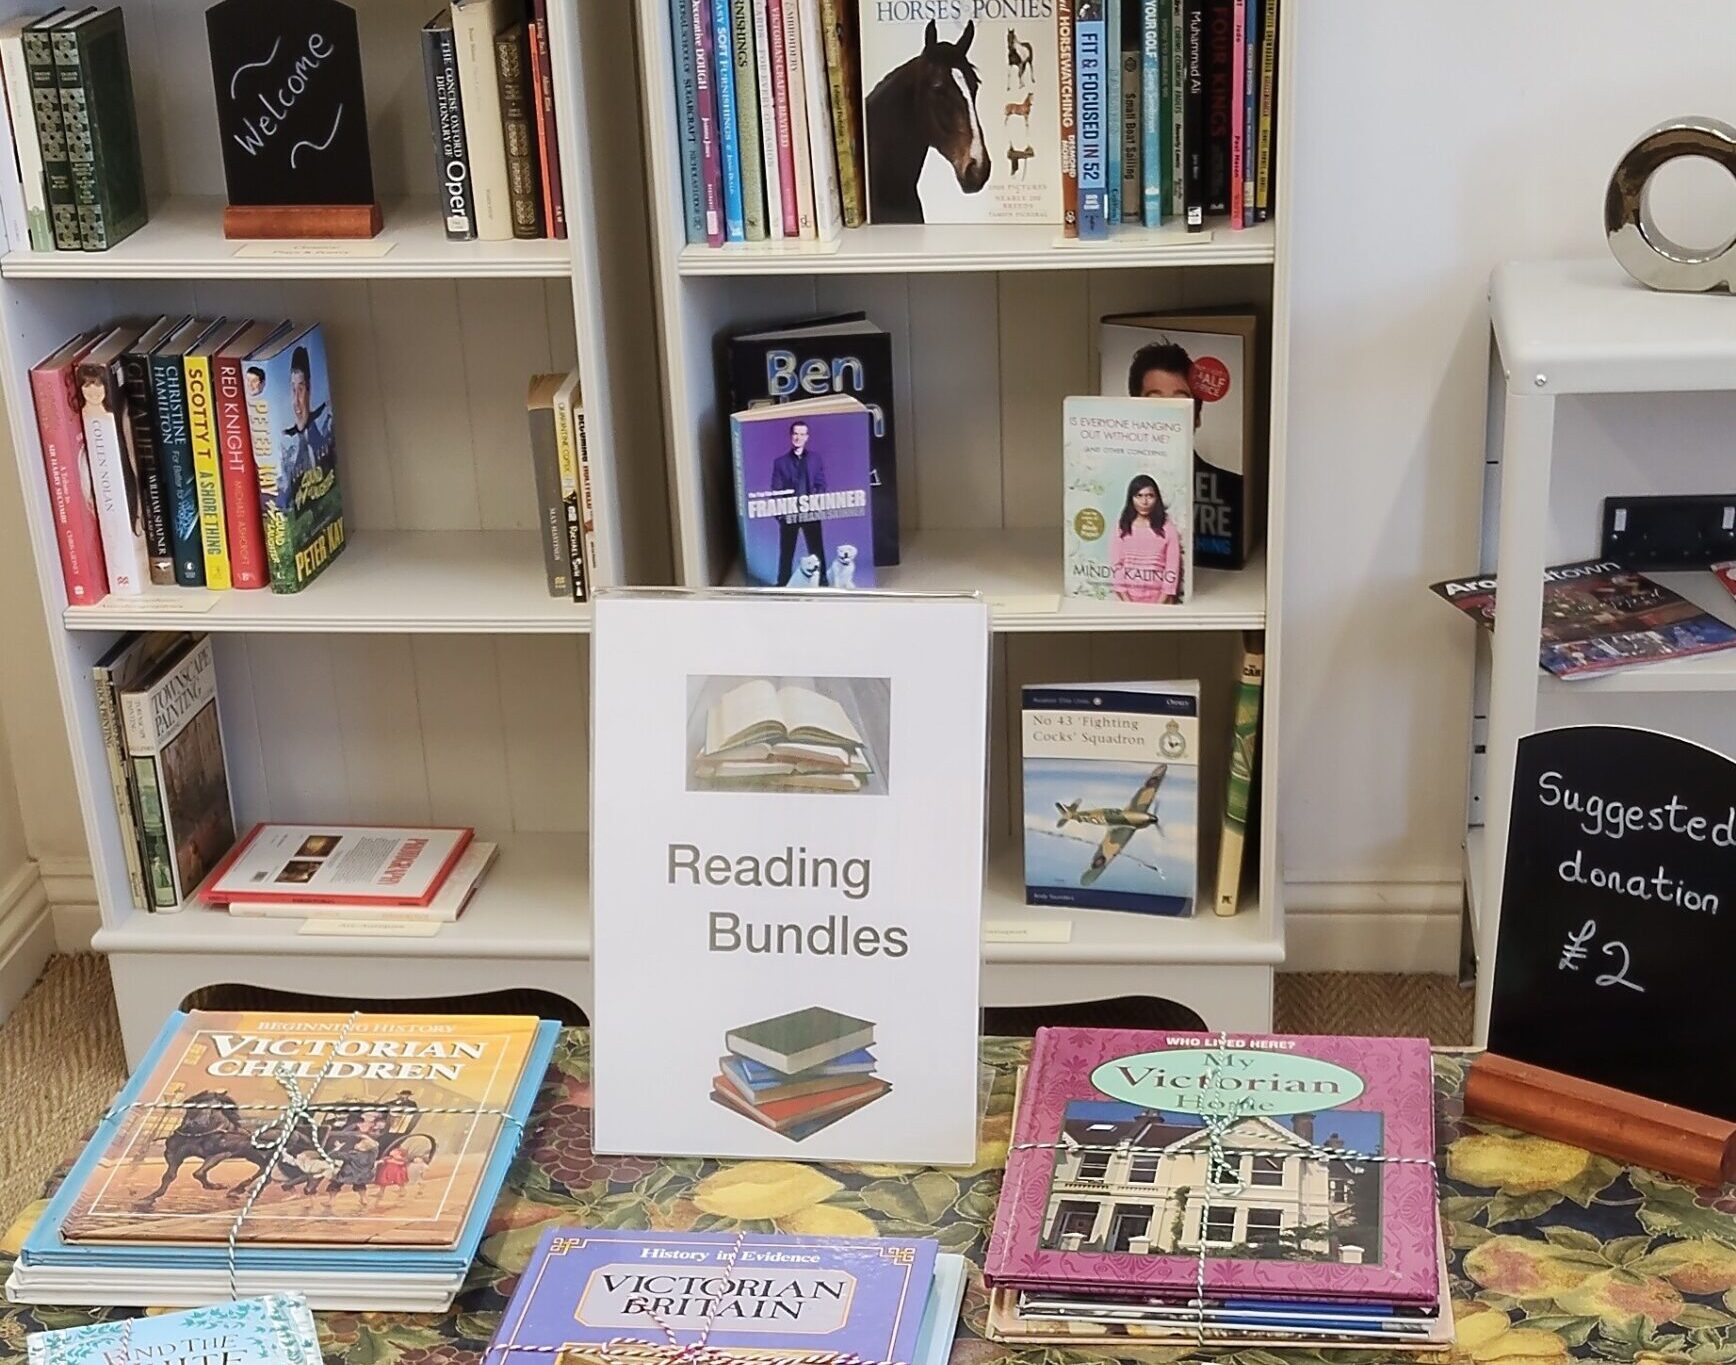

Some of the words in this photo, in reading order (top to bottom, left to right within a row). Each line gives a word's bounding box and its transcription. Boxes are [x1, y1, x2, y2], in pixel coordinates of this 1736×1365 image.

[692, 0, 704, 47] ecorative
[876, 0, 961, 22] HORSES
[972, 0, 1054, 19] PONIES
[1144, 0, 1158, 30] YOUR
[717, 27, 728, 57] SOFT
[770, 7, 784, 63] VICTORIAN
[1081, 33, 1099, 55] FIT
[1145, 31, 1159, 59] GOLF
[1189, 11, 1202, 77] Muhammad
[1213, 7, 1229, 65] FOUR
[440, 40, 452, 65] THE
[696, 48, 709, 89] DOUGH
[1082, 60, 1097, 69] &
[775, 64, 787, 104] CRAFTS
[1059, 17, 1075, 128] HORSEWATCHING
[1190, 79, 1202, 94] Ali
[232, 29, 336, 158] Welcome
[443, 67, 458, 112] CONCISE
[719, 60, 732, 141] FURNISHINGS
[761, 75, 770, 110] EVERY
[1212, 72, 1228, 137] KINGS
[435, 75, 451, 142] DICTIONARY
[443, 144, 453, 158] OF
[684, 78, 697, 143] SUGARCRAFT
[1081, 73, 1100, 140] FOCUSED
[1124, 93, 1137, 120] Small
[448, 114, 463, 158] OXFORD
[778, 105, 790, 148] REVIVED
[1124, 123, 1137, 144] Boat
[1061, 140, 1070, 173] MORRIS
[1068, 135, 1077, 178] DESMOND
[1083, 144, 1100, 159] IN
[1123, 147, 1137, 181] Sailing
[1233, 154, 1241, 179] Mason
[444, 160, 467, 216] Oper
[1083, 163, 1101, 180] 52
[220, 366, 238, 399] RED
[765, 349, 865, 398] Ben
[153, 366, 172, 444] HAMILTON
[165, 366, 187, 445] CHRISTINE
[188, 368, 210, 442] SCOTTY
[223, 403, 246, 474] KNIGHT
[249, 402, 272, 457] PETER
[1069, 416, 1078, 427] IS
[1080, 417, 1130, 430] EVERYONE
[1131, 420, 1183, 433] HANGING
[1080, 430, 1101, 440] OUT
[1103, 431, 1150, 443] WITHOUT
[171, 451, 181, 463] For
[197, 447, 211, 459] T
[49, 458, 63, 486] HARRY
[199, 471, 212, 480] A
[258, 464, 278, 496] KAY
[99, 470, 115, 512] NOLAN
[147, 474, 161, 511] WILLIAM
[200, 481, 219, 520] SHORE
[748, 497, 799, 518] FRANK
[799, 489, 867, 514] SKINNER
[151, 511, 167, 556] SHATNER
[204, 520, 223, 556] THING
[295, 535, 327, 583] PETER
[326, 516, 345, 554] KAY
[1073, 563, 1120, 580] MINDY
[1123, 566, 1178, 585] KALING
[1033, 714, 1052, 726] No
[1057, 715, 1073, 727] 43
[1081, 731, 1146, 748] Squadron
[1538, 770, 1736, 848] Suggested
[666, 842, 873, 900] Reading
[1557, 849, 1720, 916] donation
[707, 910, 910, 958] Bundles
[256, 1020, 369, 1034] BEGINNING
[371, 1022, 457, 1035] HISTORY
[1165, 1035, 1202, 1048] WHO
[1203, 1037, 1247, 1050] LIED
[1249, 1038, 1297, 1051] HERE?
[209, 1033, 490, 1060] VICTORIAN
[1201, 1051, 1256, 1072] My
[206, 1058, 466, 1082] CHILDREN
[1114, 1064, 1343, 1096] Victorian
[640, 1246, 711, 1264] History
[715, 1247, 735, 1262] in
[740, 1249, 823, 1265] Evidence
[600, 1273, 849, 1301] VICTORIAN
[619, 1297, 807, 1322] BRITAIN
[181, 1333, 240, 1353] THE
